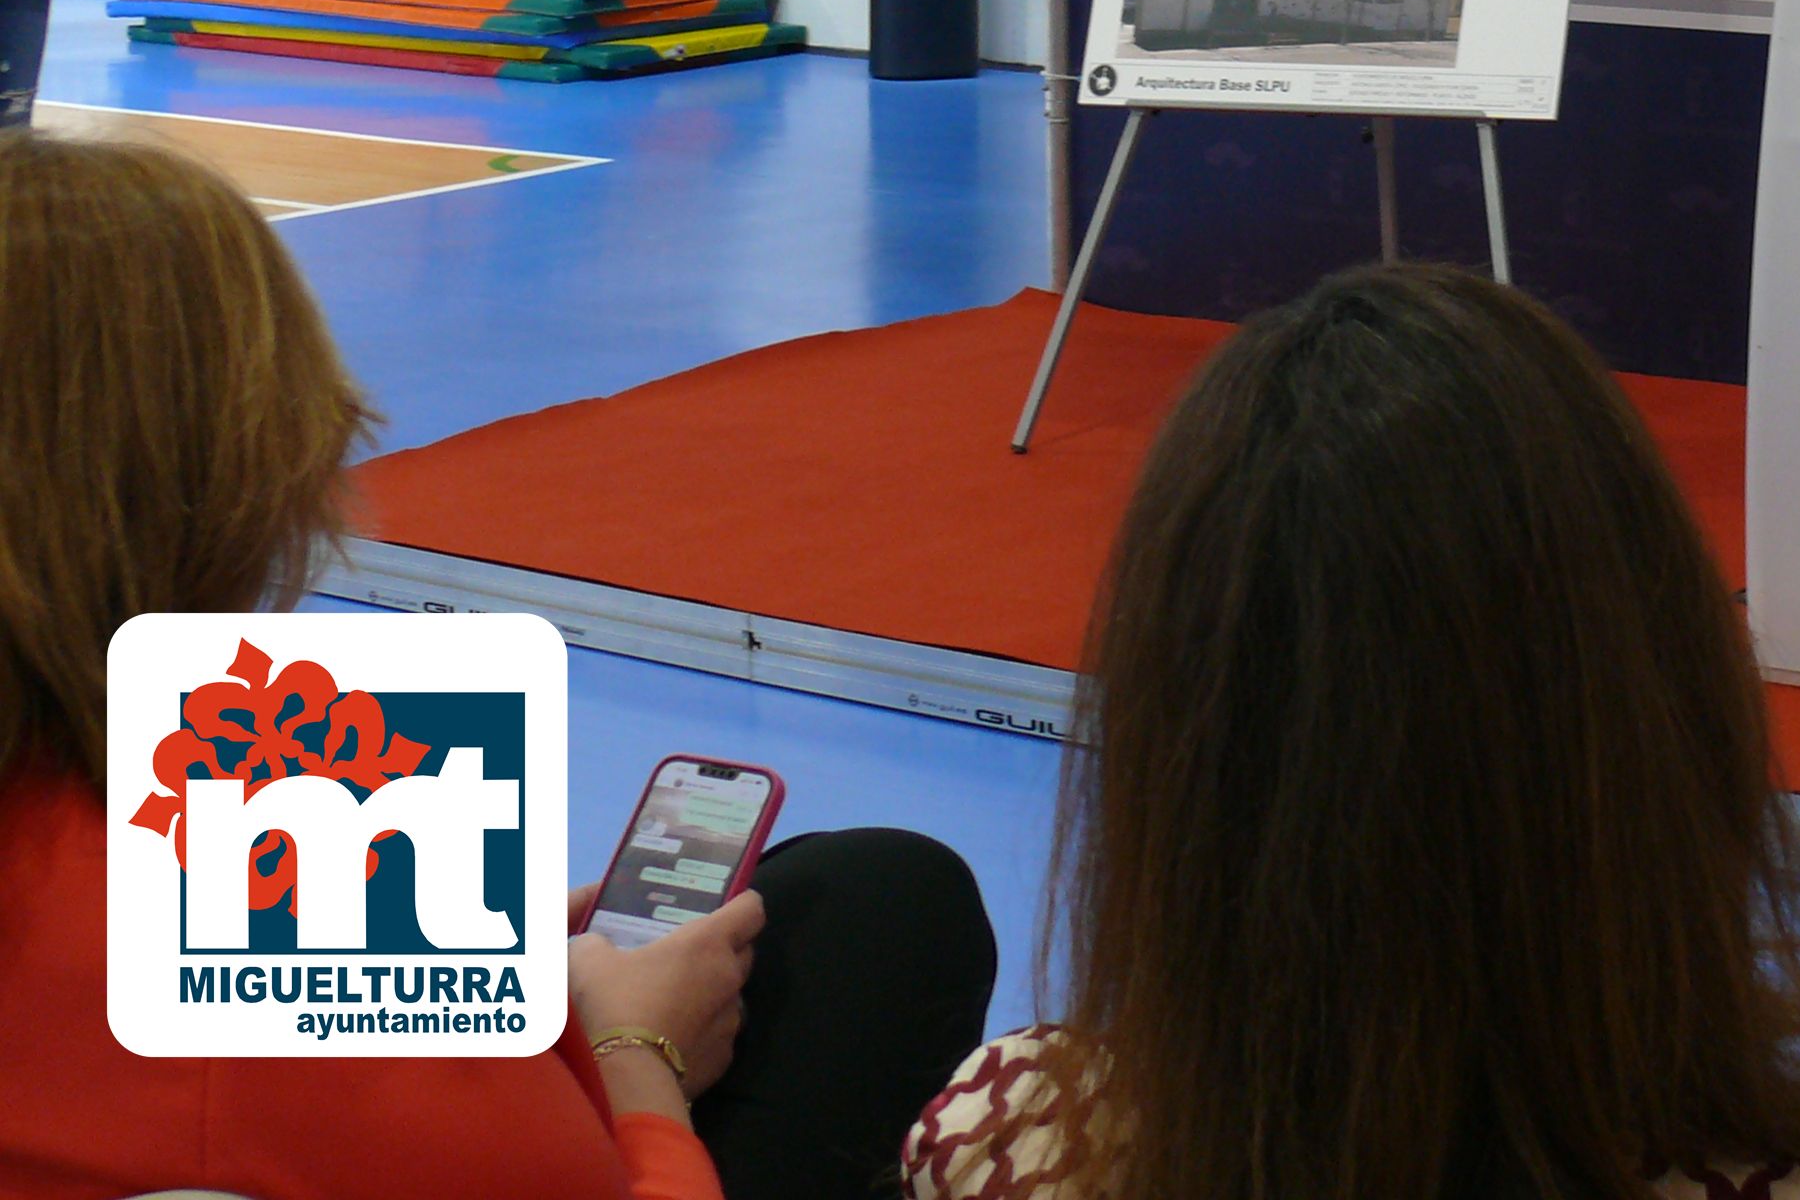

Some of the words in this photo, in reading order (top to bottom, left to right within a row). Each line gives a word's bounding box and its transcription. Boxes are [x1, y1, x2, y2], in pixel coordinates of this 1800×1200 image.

[1135, 76, 1216, 91] Arquitectura
[1219, 78, 1251, 92] Base
[975, 708, 1074, 739] GUIL
